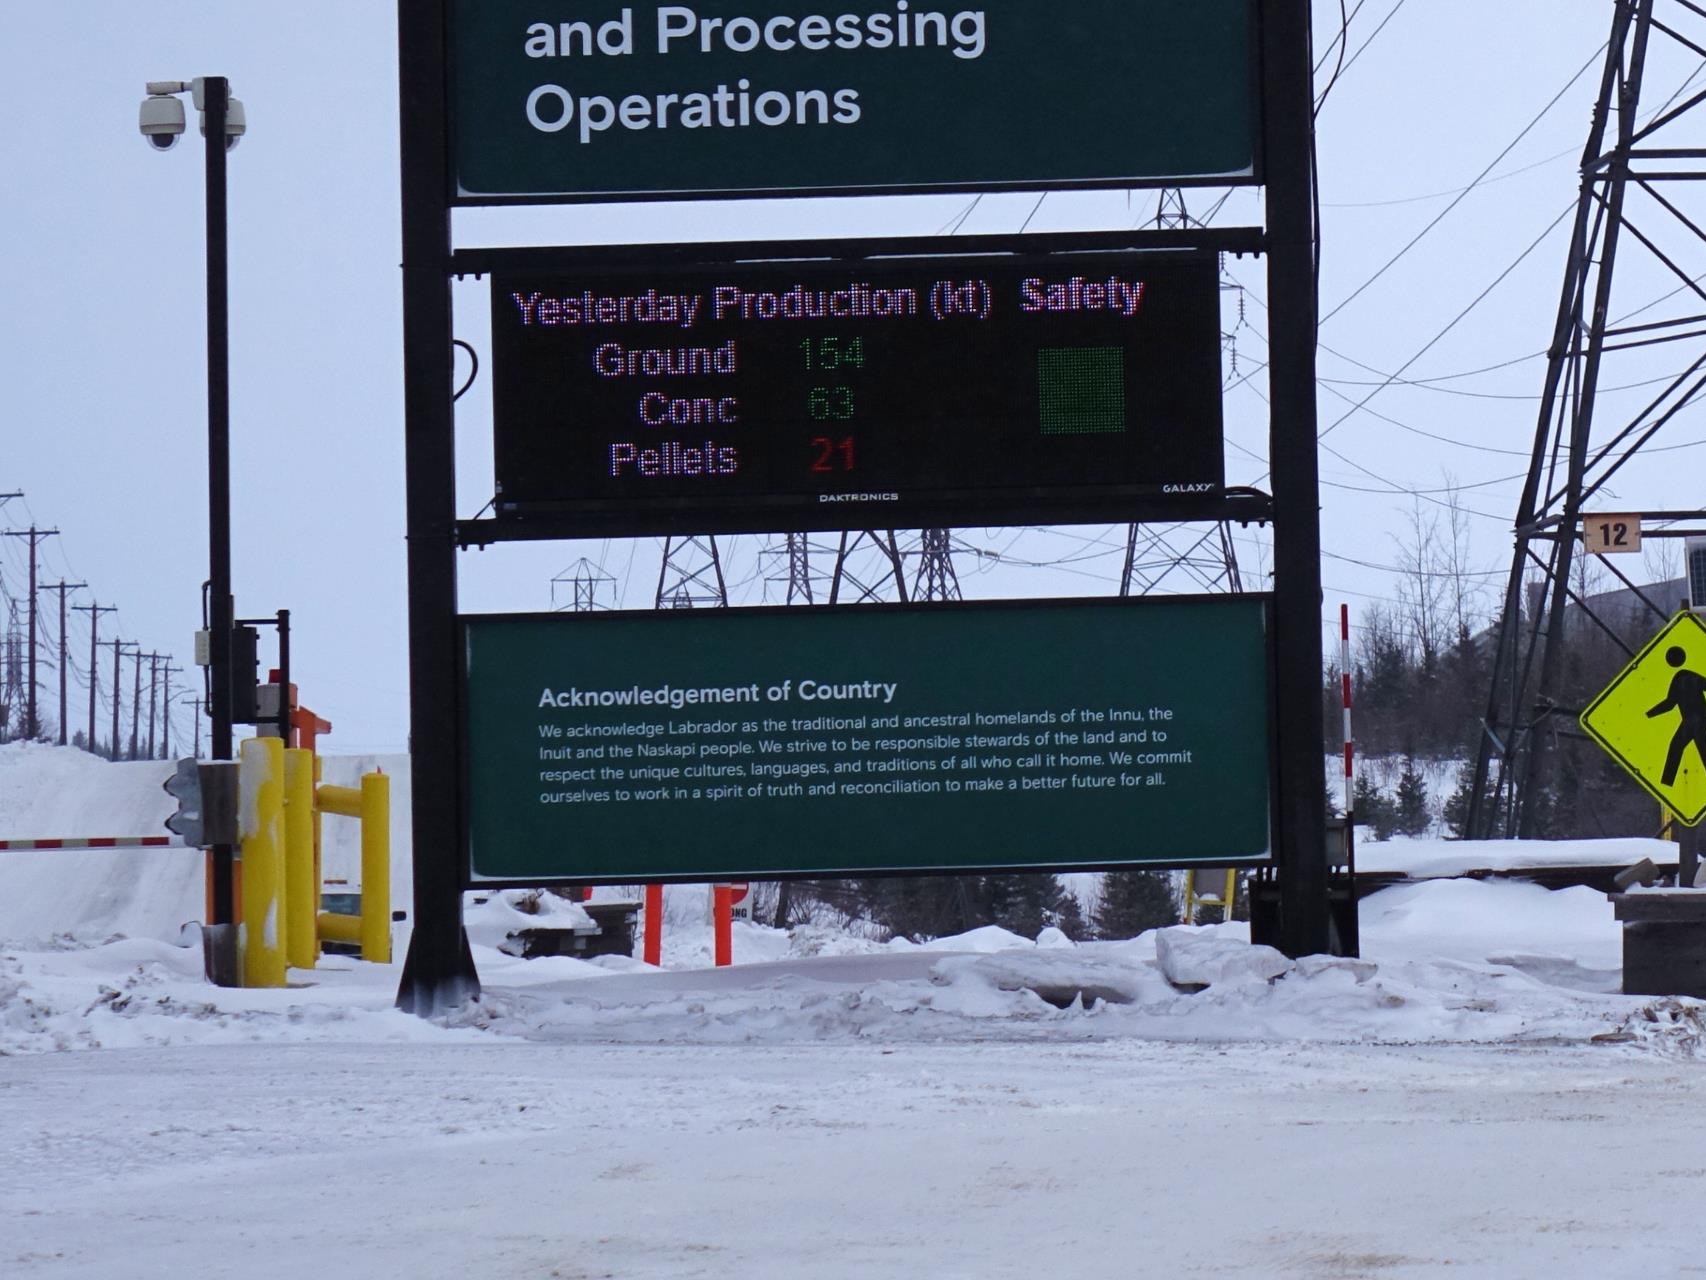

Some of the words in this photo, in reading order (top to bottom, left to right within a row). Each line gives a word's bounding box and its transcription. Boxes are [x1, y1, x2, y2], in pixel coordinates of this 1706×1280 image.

[524, 7, 633, 58] and
[657, 0, 986, 59] Processing
[525, 79, 861, 144] Operations
[512, 288, 702, 328] Yesterday
[713, 282, 916, 320] Production
[929, 280, 992, 320] (kt)
[1019, 276, 1144, 316] Safety
[593, 340, 736, 376] Ground
[799, 336, 864, 370] 154
[640, 391, 738, 425] Conc
[809, 387, 854, 419] 63
[609, 440, 738, 476] Pellets
[809, 435, 854, 472] 21
[819, 492, 899, 503] DAKTRONICS
[1600, 523, 1627, 546] 12
[538, 683, 760, 710] Acknowledgement
[766, 679, 791, 702] of
[798, 680, 898, 704] Country
[537, 723, 563, 739] We
[565, 721, 665, 739] acknowledge
[668, 718, 739, 736] Labrador
[740, 720, 759, 734] as
[761, 717, 788, 733] the
[790, 714, 867, 732] traditional
[870, 714, 900, 730] and
[902, 711, 971, 729] ancestral
[974, 709, 1057, 726] homelands
[1059, 707, 1077, 724] of
[1079, 708, 1106, 723] the
[1108, 707, 1145, 722] Innu,
[1147, 706, 1174, 722] the
[539, 745, 573, 761] Inuit
[575, 744, 605, 760] and
[607, 743, 634, 759] the
[637, 741, 696, 760] Naskapi
[699, 740, 756, 759] people.
[757, 739, 784, 754] We
[785, 738, 828, 754] strive
[830, 738, 848, 752] to
[850, 736, 872, 752] be
[874, 734, 962, 754] responsible
[964, 731, 1031, 749] stewards
[1034, 729, 1051, 747] of
[1053, 730, 1080, 746] the
[1082, 729, 1116, 745] land
[1118, 728, 1148, 744] and
[1150, 729, 1168, 743] to
[539, 767, 597, 785] respect
[599, 765, 625, 781] the
[628, 764, 681, 782] unique
[682, 763, 747, 778] cultures,
[750, 761, 831, 780] languages,
[833, 758, 862, 774] and
[865, 756, 938, 773] traditions
[940, 754, 957, 771] of
[959, 754, 978, 770] all
[980, 754, 1013, 769] who
[1015, 752, 1042, 769] call
[1045, 752, 1057, 768] it
[1059, 752, 1106, 767] home.
[1108, 750, 1133, 766] We
[1135, 748, 1193, 766] commit
[539, 788, 611, 805] ourselves
[614, 788, 631, 802] to
[633, 786, 671, 801] work
[674, 786, 688, 800] in
[691, 787, 702, 800] a
[705, 783, 744, 802] spirit
[746, 781, 764, 798] of
[766, 781, 804, 798] truth
[807, 780, 837, 797] and
[839, 778, 941, 795] reconciliation
[944, 778, 962, 793] to
[964, 776, 1005, 792] make
[1007, 778, 1018, 791] a
[1021, 775, 1068, 791] better
[1070, 773, 1117, 789] future
[1119, 771, 1143, 787] for
[1145, 771, 1167, 787] all.
